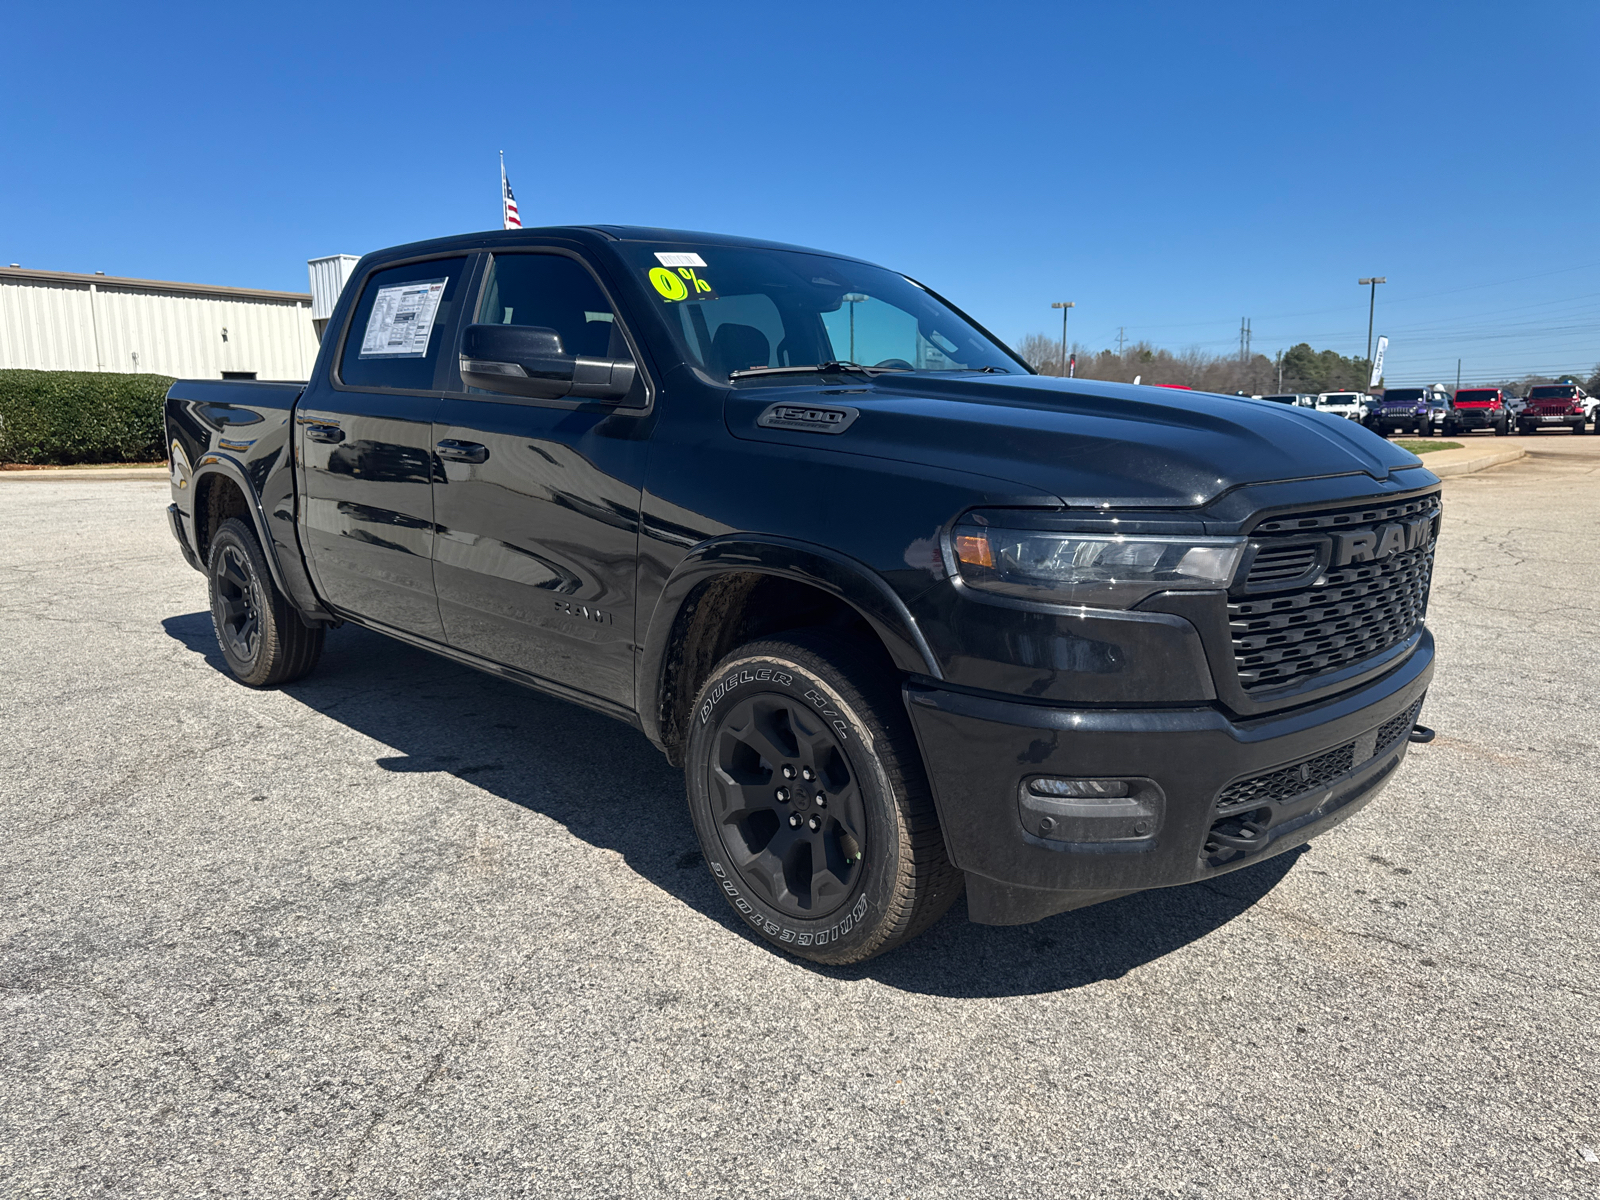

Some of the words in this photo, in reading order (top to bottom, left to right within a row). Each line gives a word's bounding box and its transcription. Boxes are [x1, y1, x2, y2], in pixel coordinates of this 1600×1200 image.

[649, 267, 711, 301] 0%
[1375, 351, 1383, 373] Jeep
[769, 407, 843, 423] 1500
[1335, 516, 1430, 567] RAM
[700, 668, 793, 724] DUELER
[711, 861, 868, 946] BRIDGESTONE
